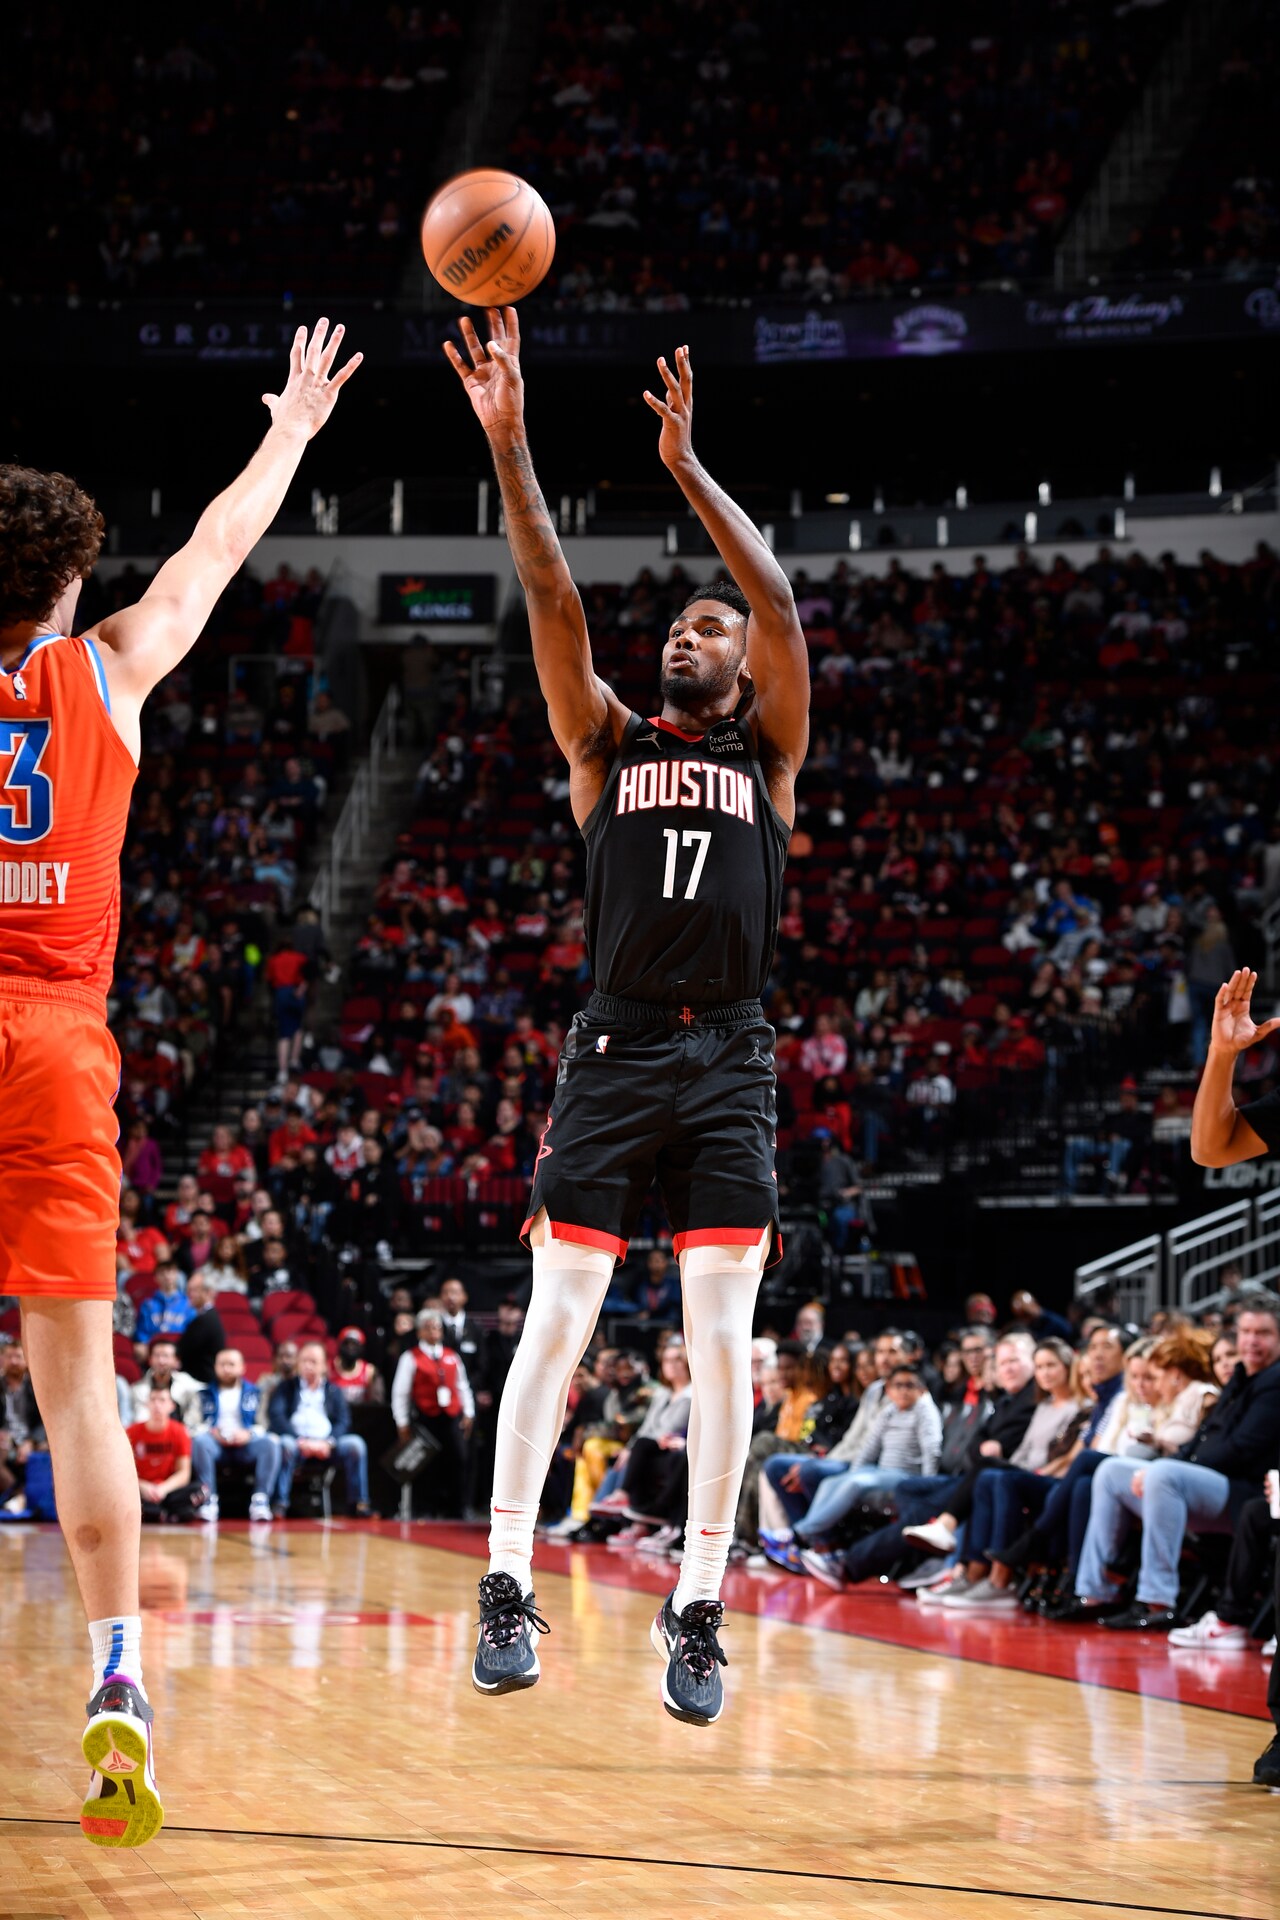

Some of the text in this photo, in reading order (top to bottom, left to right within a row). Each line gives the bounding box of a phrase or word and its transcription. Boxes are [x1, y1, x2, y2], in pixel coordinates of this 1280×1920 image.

[443, 222, 515, 287] Wilson
[139, 323, 314, 345] GROTT
[408, 603, 474, 620] KINGS
[709, 742, 744, 752] karma
[0, 717, 54, 845] 3
[616, 761, 754, 825] HOUSTON
[662, 828, 712, 900] 17
